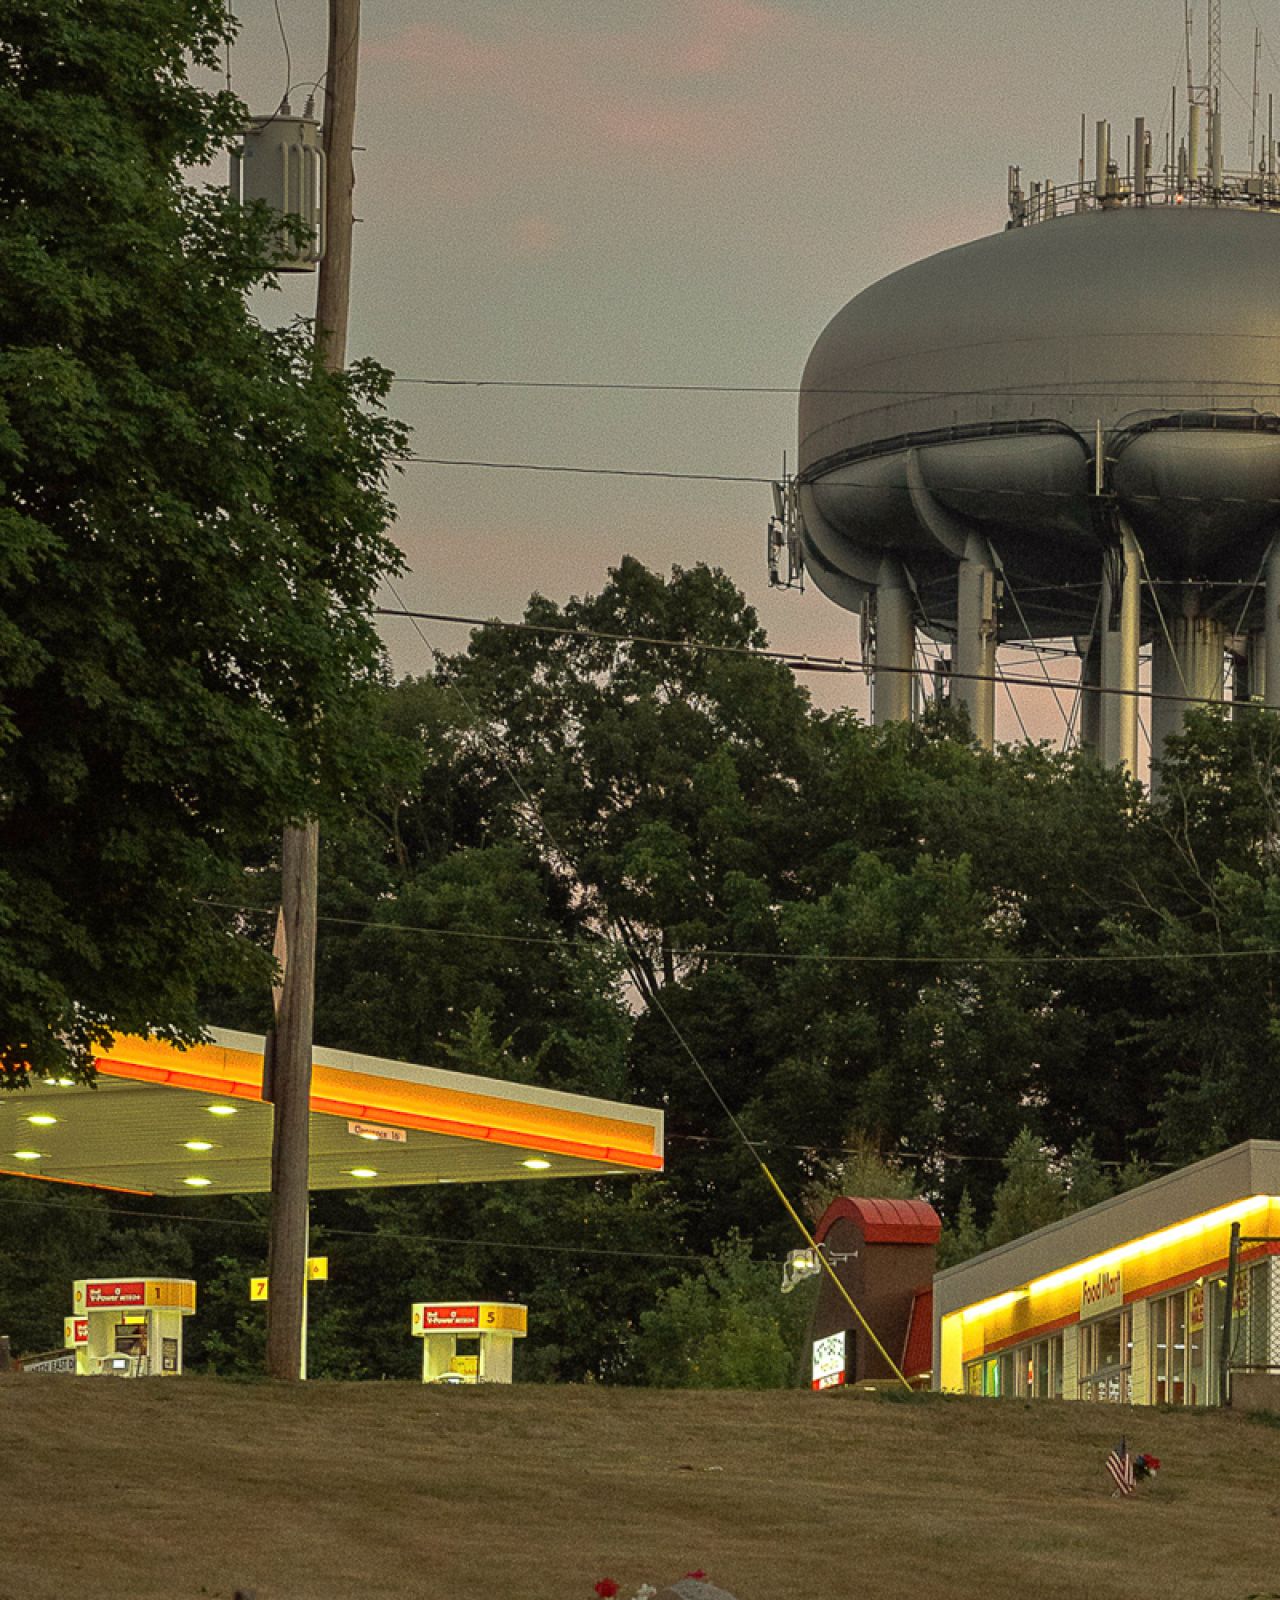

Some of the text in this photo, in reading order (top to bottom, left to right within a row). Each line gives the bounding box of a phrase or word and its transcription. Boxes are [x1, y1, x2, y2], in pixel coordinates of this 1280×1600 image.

[154, 1287, 161, 1299] 1
[257, 1282, 265, 1296] 7
[1082, 1270, 1121, 1306] Food Mart
[487, 1312, 496, 1323] 5
